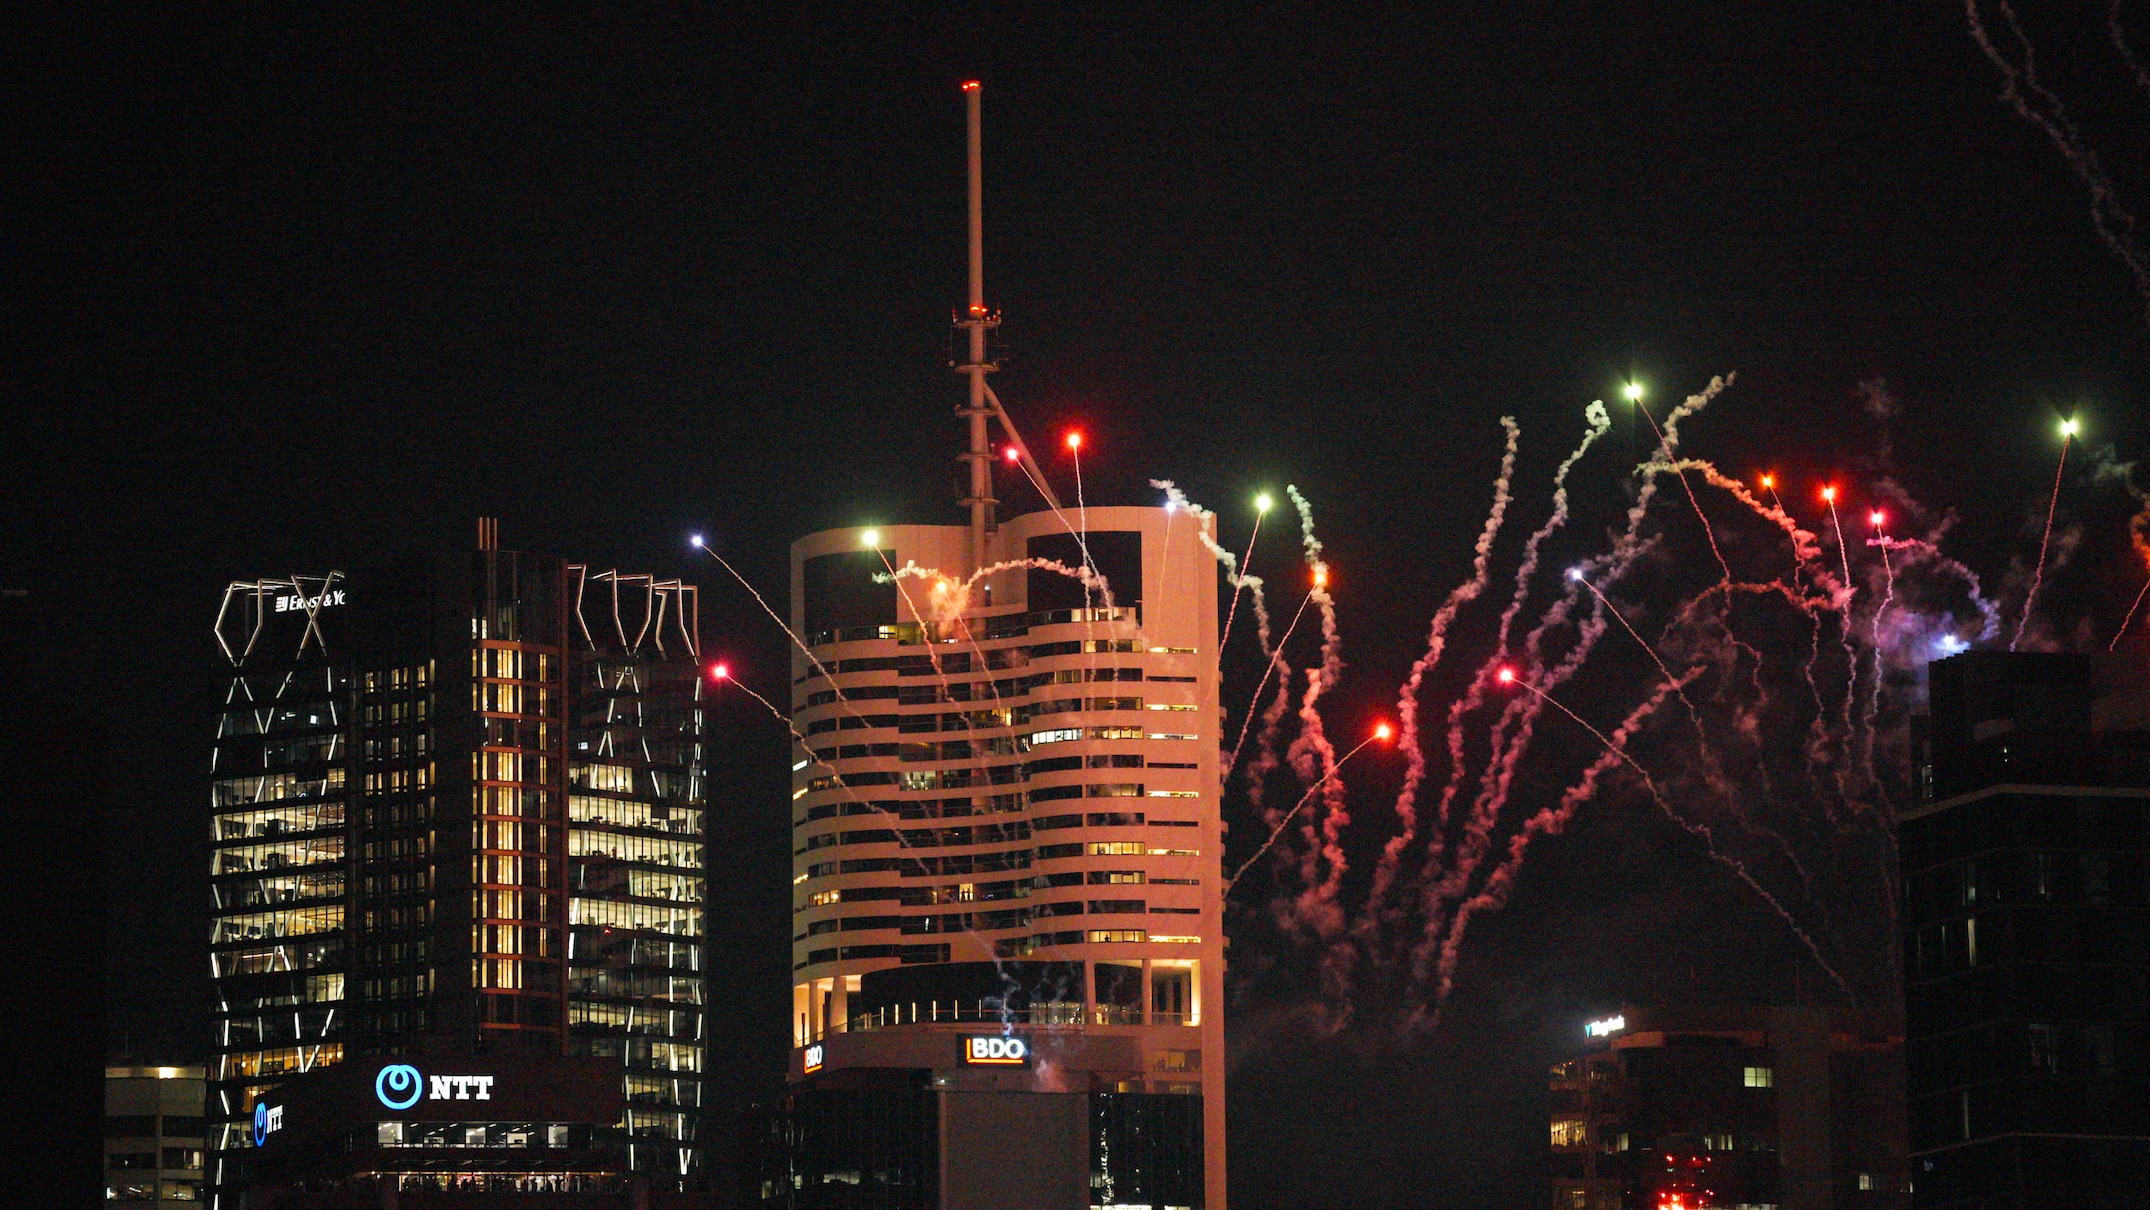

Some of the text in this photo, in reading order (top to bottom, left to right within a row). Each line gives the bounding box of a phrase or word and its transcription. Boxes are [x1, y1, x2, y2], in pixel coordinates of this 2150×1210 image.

[323, 594, 332, 607] &
[806, 1045, 823, 1068] BDO
[972, 1038, 1024, 1059] BDO
[429, 1075, 494, 1101] NTT
[266, 1105, 283, 1134] NTT
